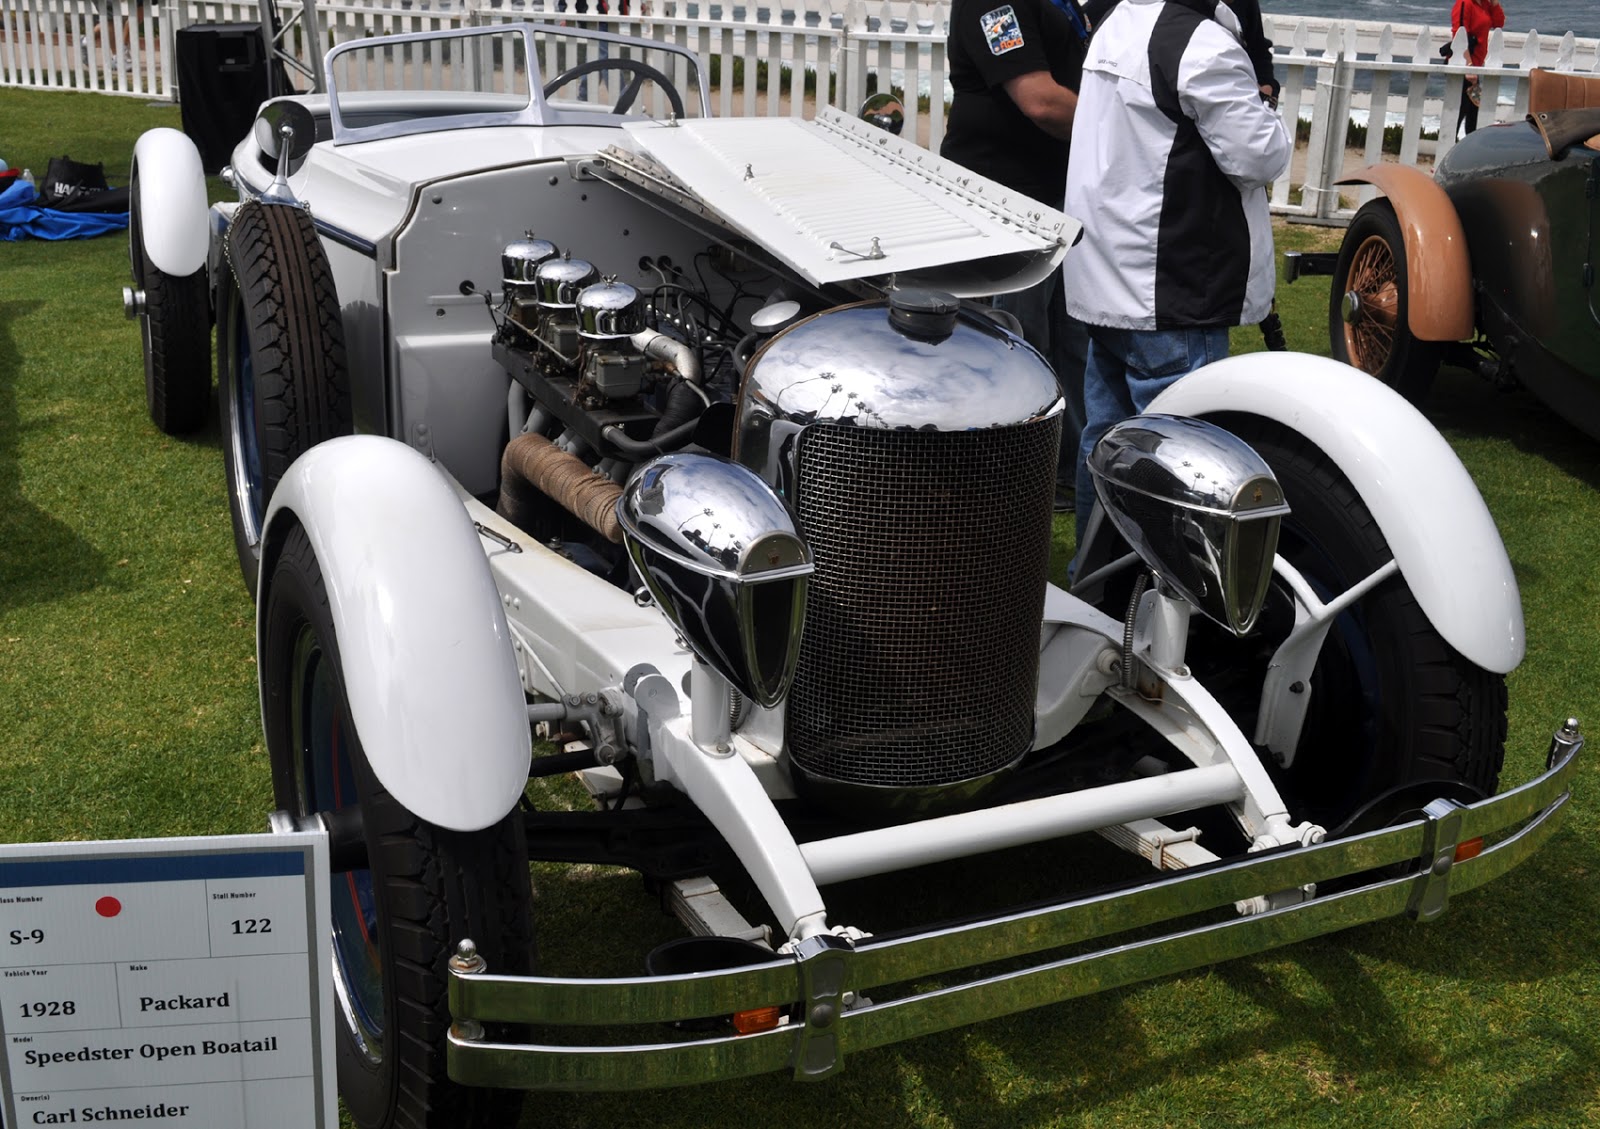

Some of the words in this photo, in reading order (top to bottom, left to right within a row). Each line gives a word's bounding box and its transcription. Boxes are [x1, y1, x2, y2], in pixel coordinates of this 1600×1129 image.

[212, 892, 228, 900] Stall
[230, 891, 256, 899] Number
[231, 918, 272, 935] 122
[9, 929, 45, 946] S-9
[4, 970, 30, 978] Vehicle
[129, 964, 148, 972] Make
[19, 1000, 76, 1018] 1928
[139, 992, 230, 1012] Packard
[24, 1046, 134, 1067] Speedster
[139, 1043, 196, 1062] Open
[201, 1036, 278, 1055] Boatail
[20, 1094, 50, 1102] Owner(s)
[32, 1108, 76, 1125] Carl
[81, 1103, 190, 1122] Schneider
